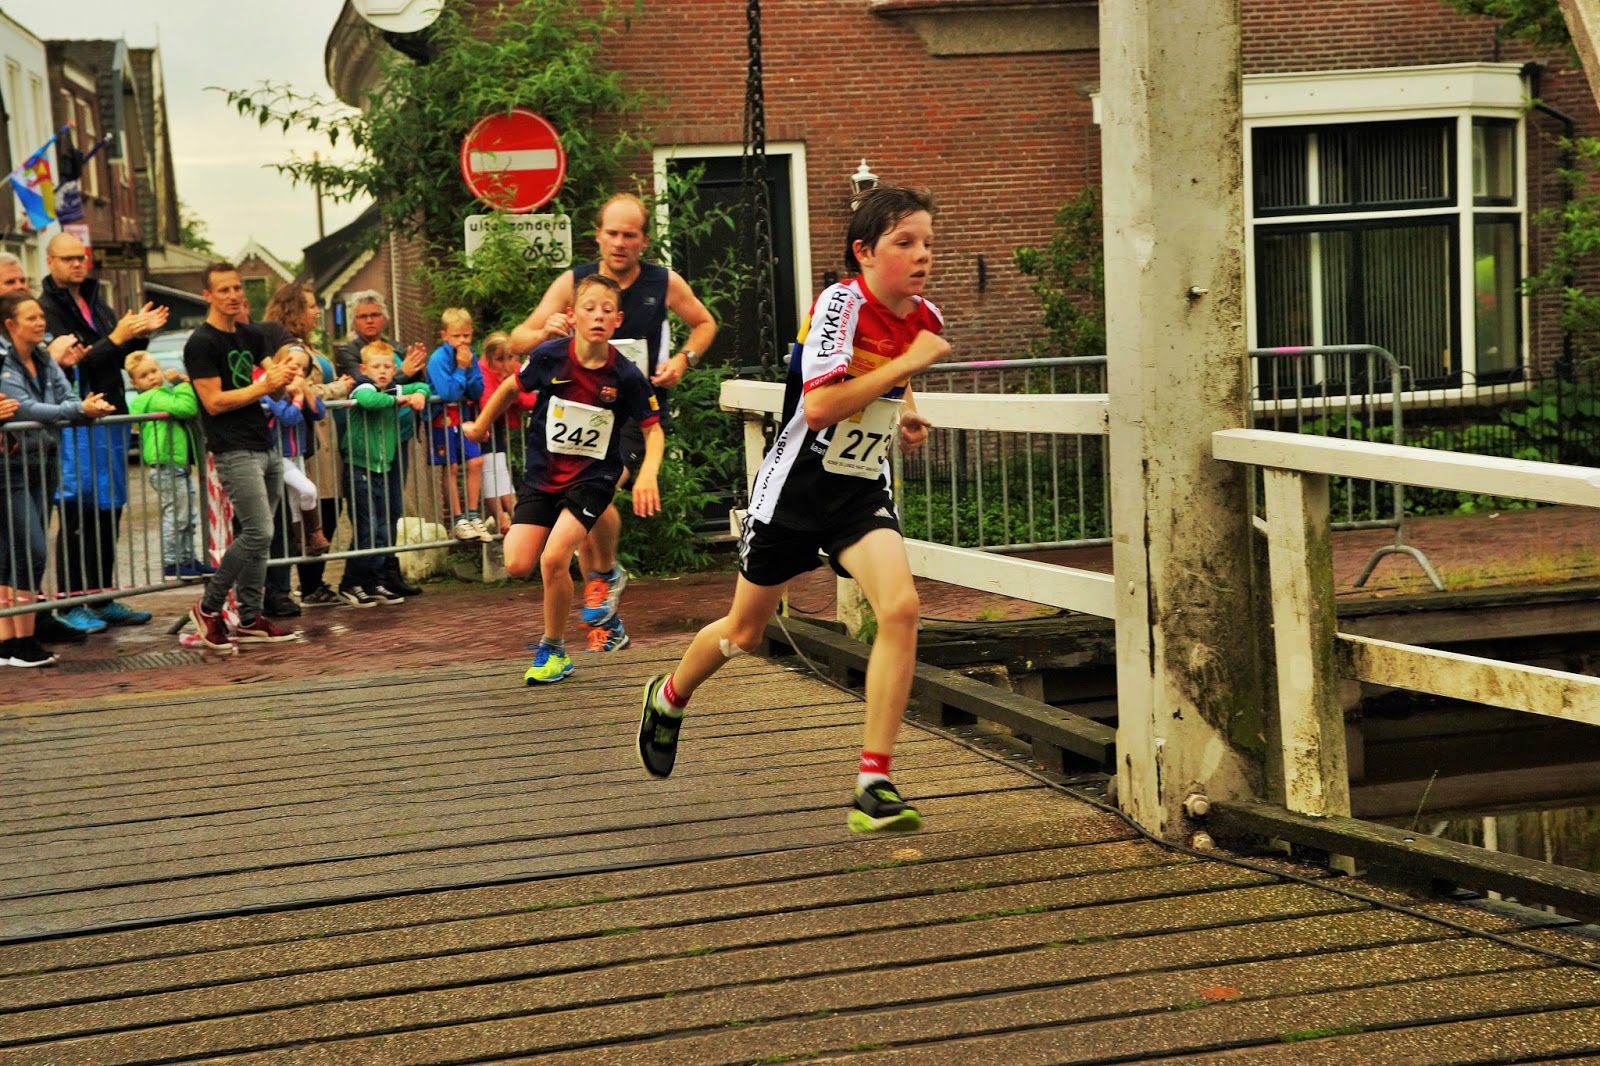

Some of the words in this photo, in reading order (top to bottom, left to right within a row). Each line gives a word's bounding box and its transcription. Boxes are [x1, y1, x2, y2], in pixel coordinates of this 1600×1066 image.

[470, 219, 566, 231] uitgzonderd
[817, 290, 848, 358] FOKKER
[551, 422, 601, 448] 242
[839, 429, 891, 465] 273
[762, 467, 775, 490] VAN
